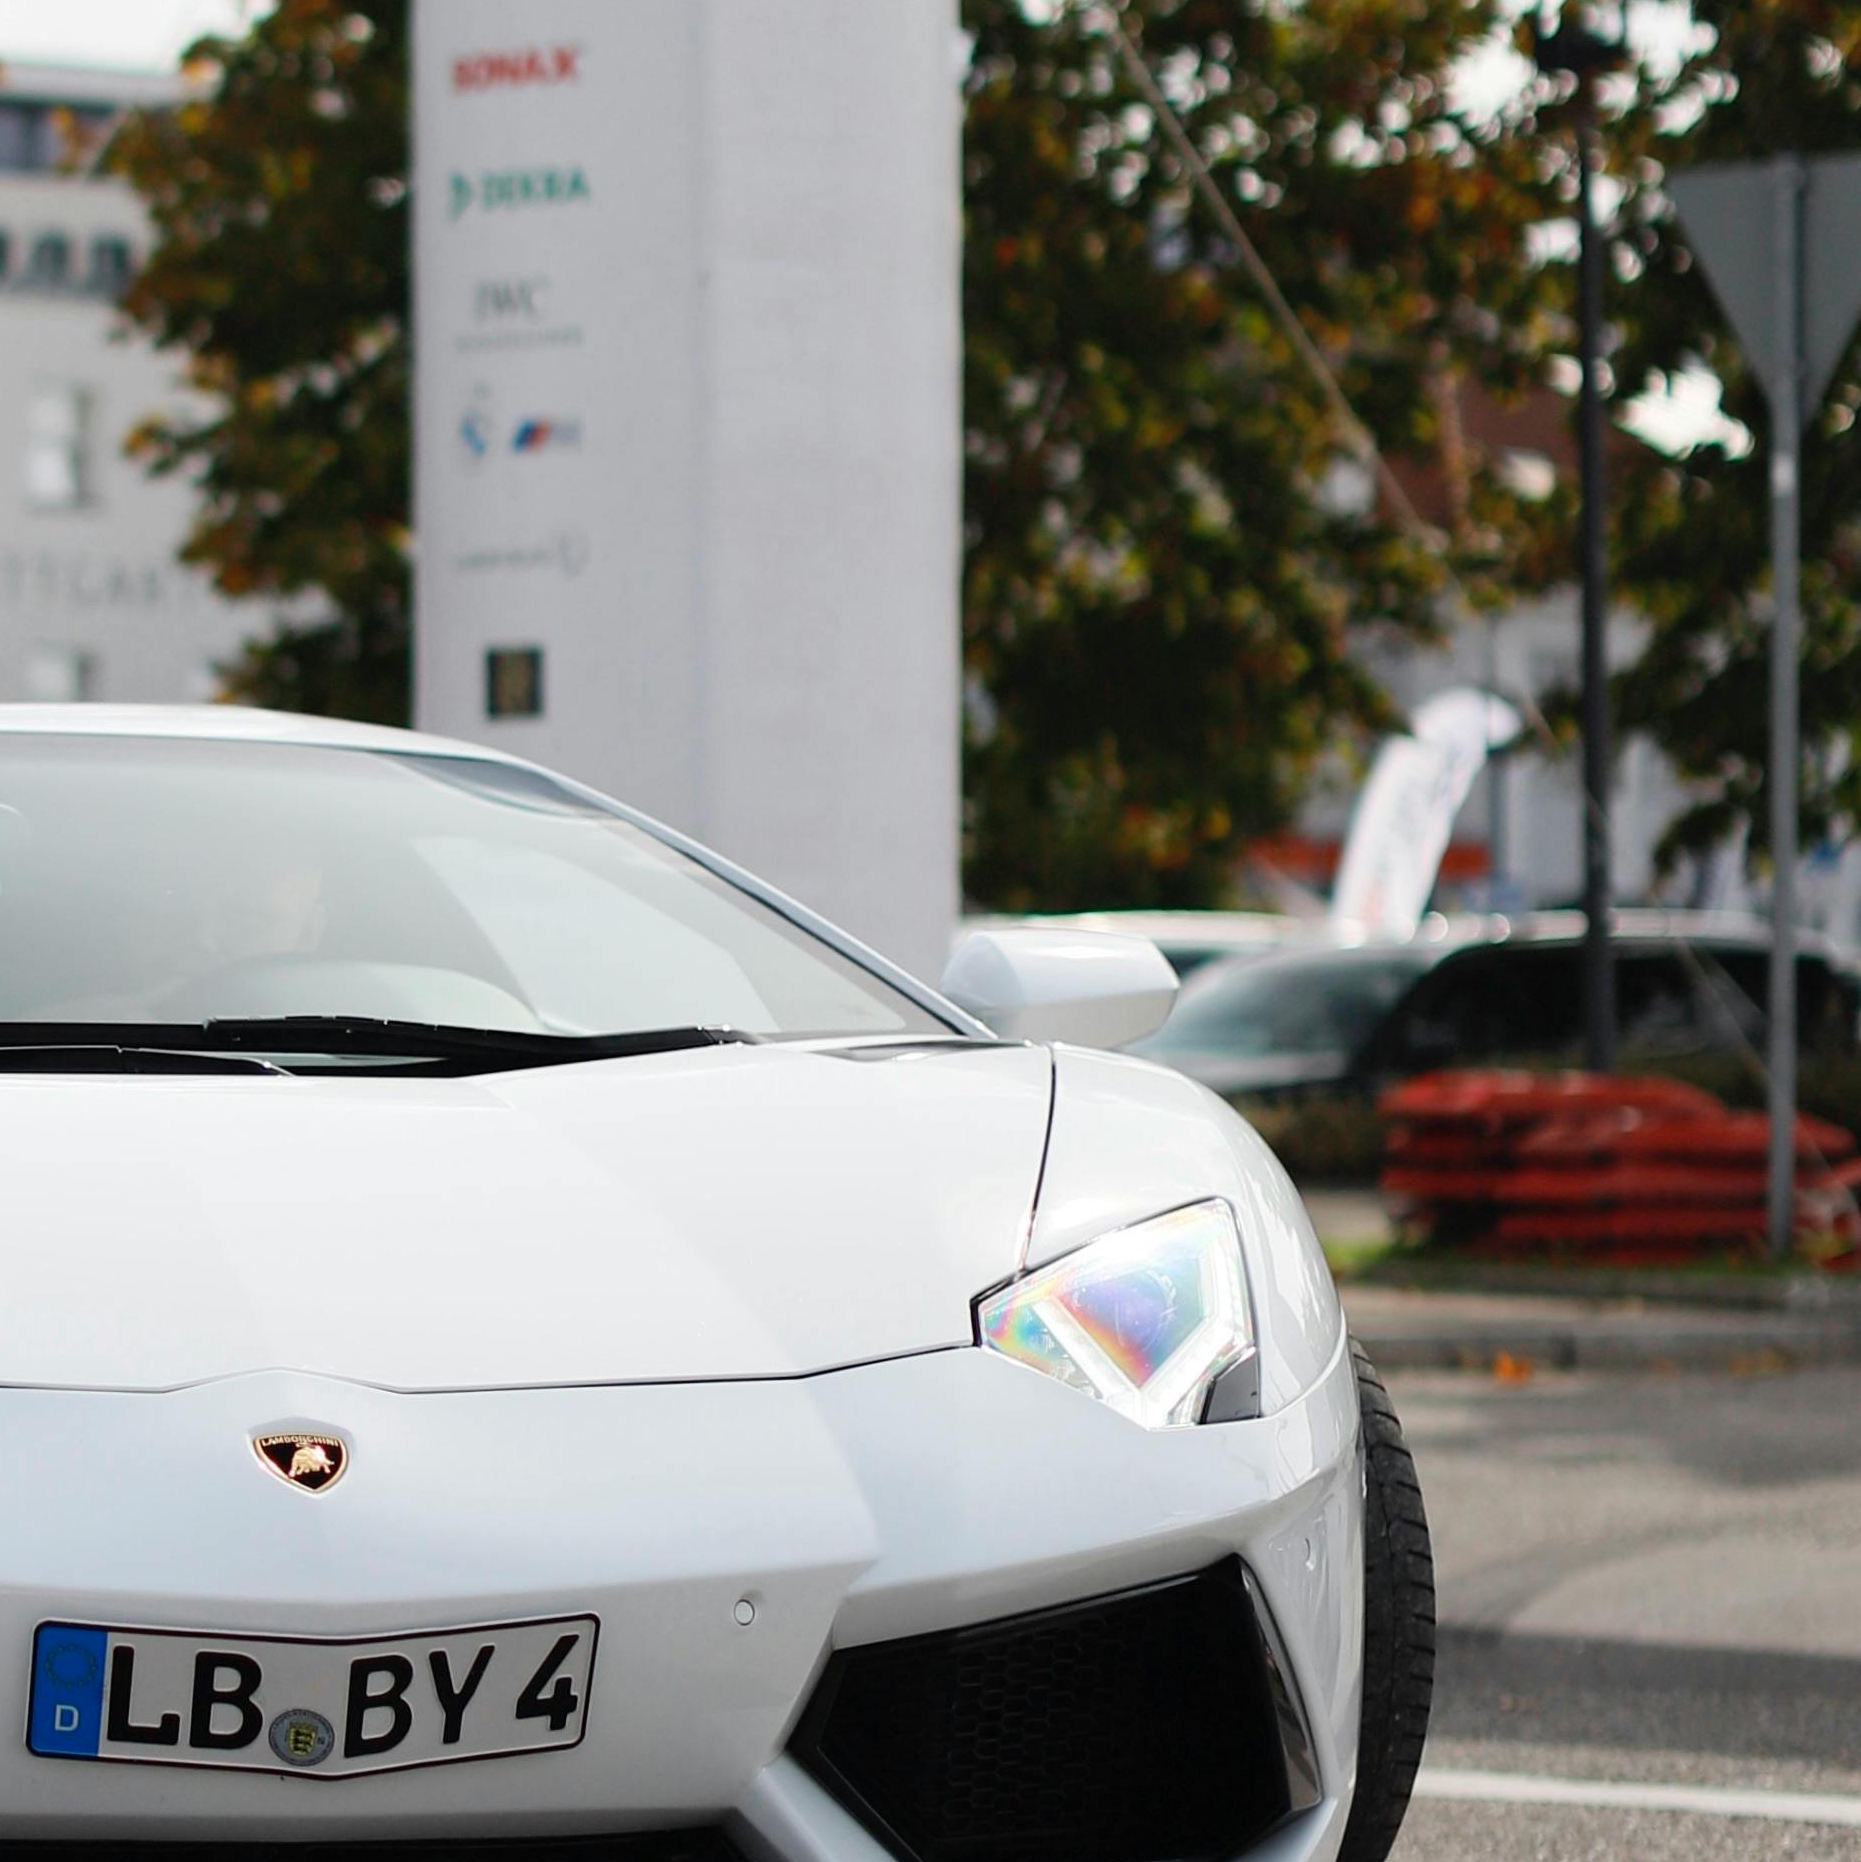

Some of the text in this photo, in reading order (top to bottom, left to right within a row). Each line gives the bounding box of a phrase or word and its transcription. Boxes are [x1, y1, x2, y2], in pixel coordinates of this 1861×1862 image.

[54, 1704, 79, 1732] D
[107, 1645, 264, 1750] LB
[343, 1644, 496, 1759] BY
[515, 1634, 580, 1731] 4
